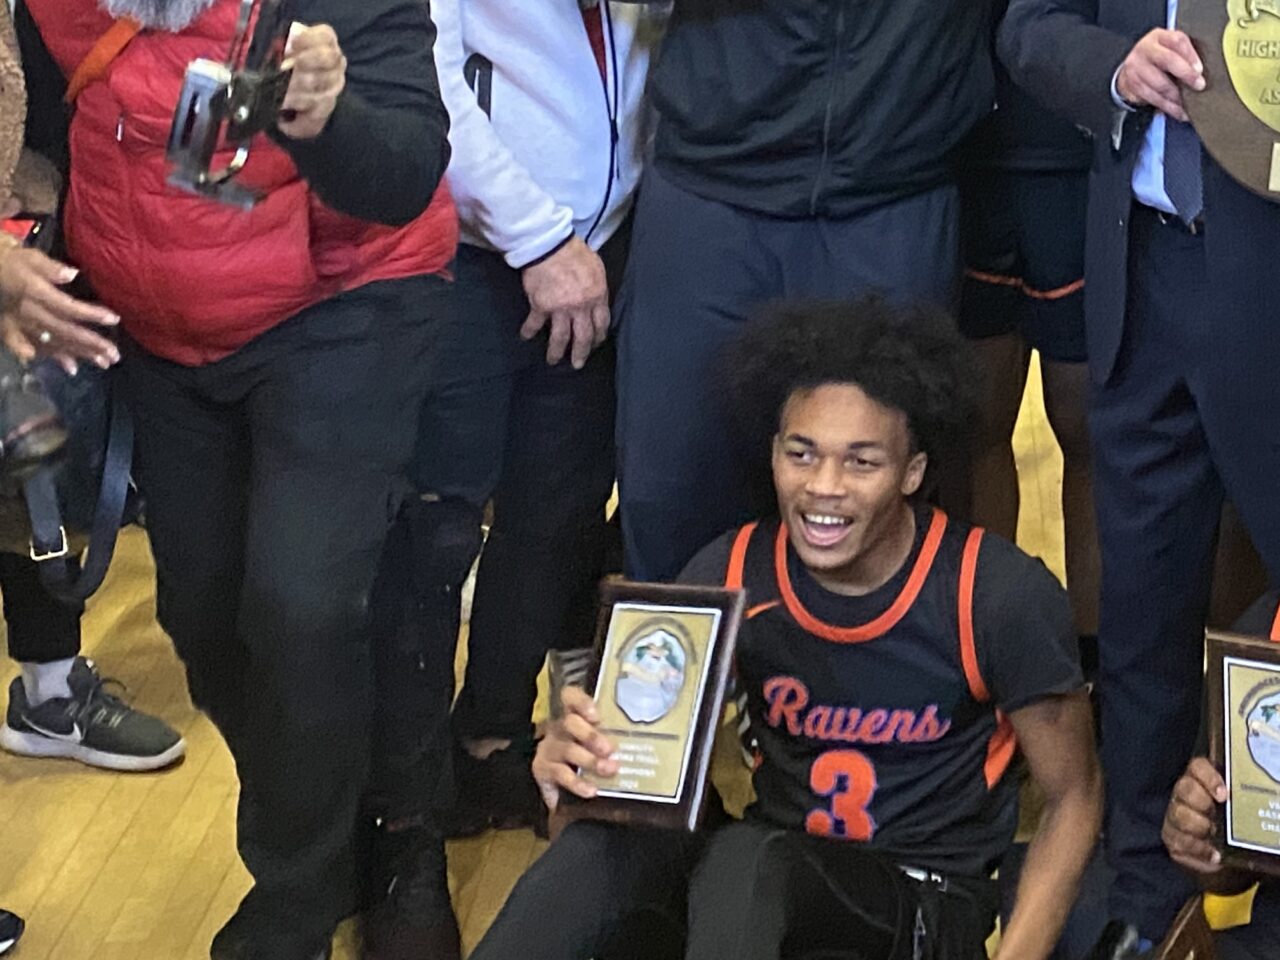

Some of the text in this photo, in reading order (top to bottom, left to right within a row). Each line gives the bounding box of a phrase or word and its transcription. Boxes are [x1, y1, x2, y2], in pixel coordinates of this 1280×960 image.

[1237, 38, 1280, 59] HIGH
[763, 675, 951, 744] Ravens
[805, 748, 880, 841] 3
